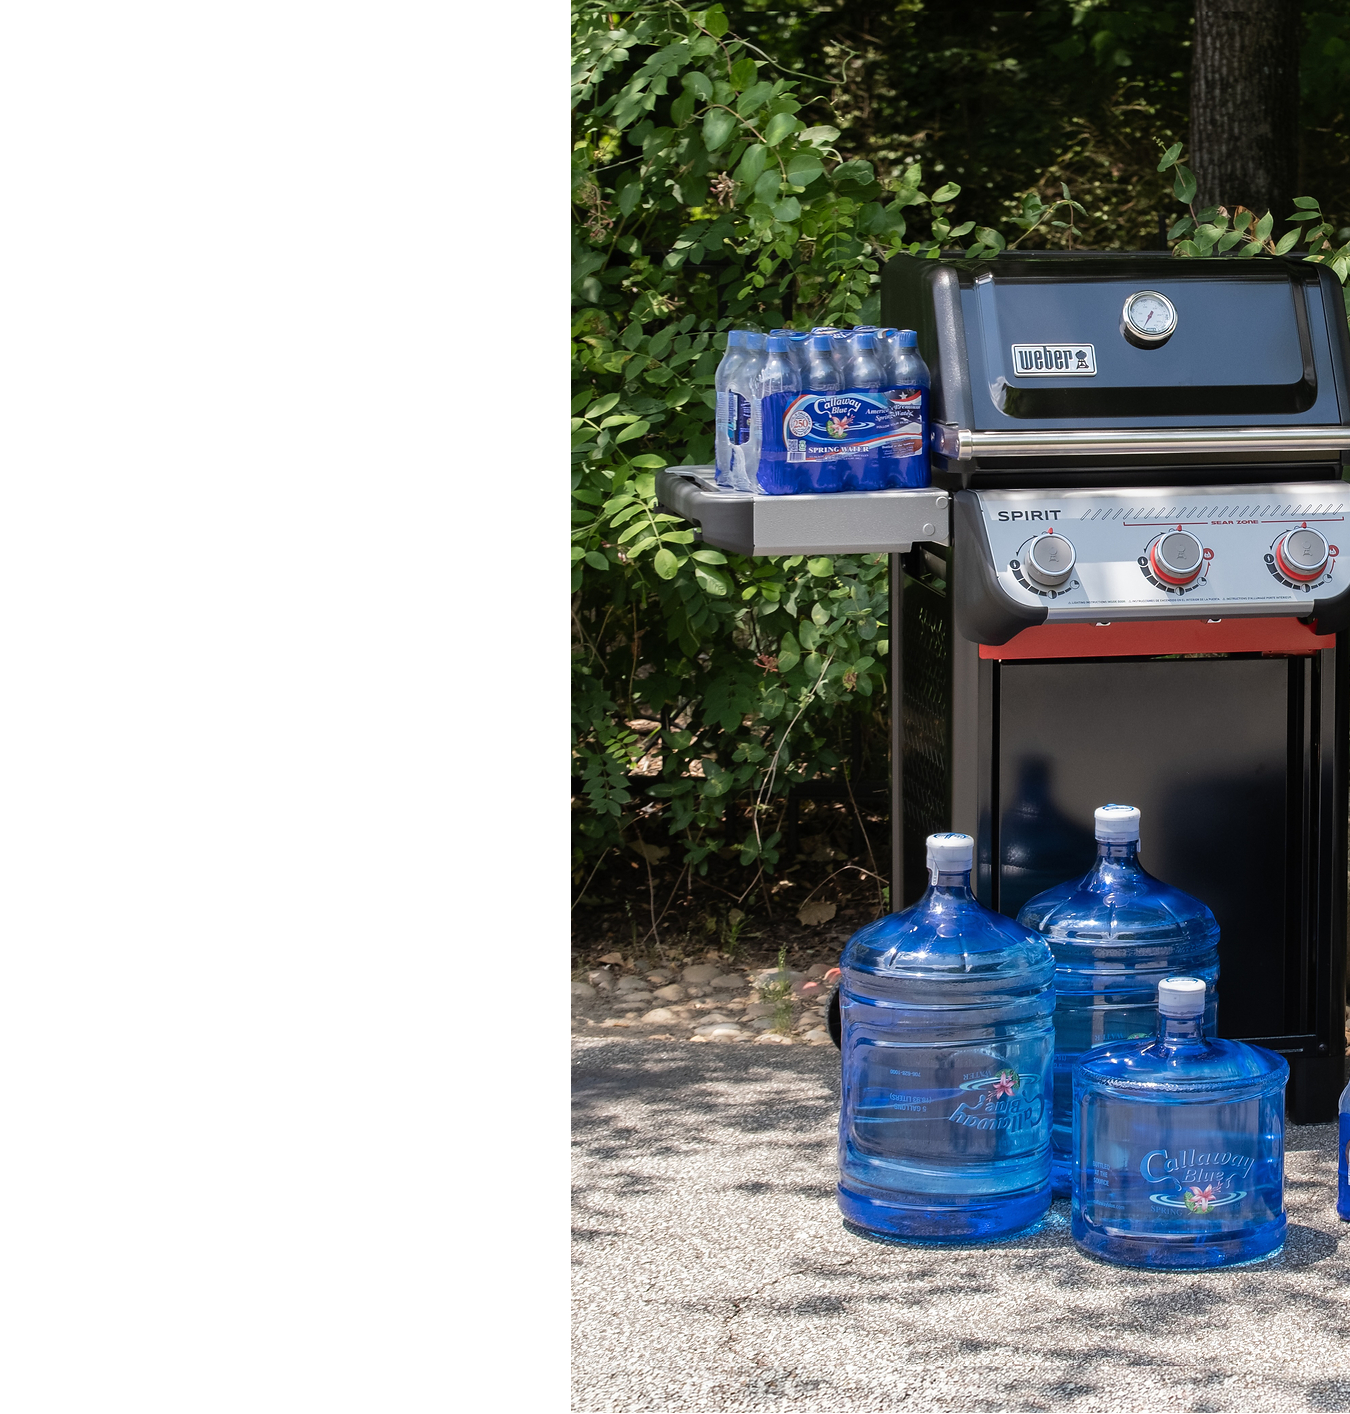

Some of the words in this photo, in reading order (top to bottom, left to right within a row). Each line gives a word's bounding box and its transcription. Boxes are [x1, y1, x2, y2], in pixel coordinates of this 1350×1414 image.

[1018, 346, 1073, 371] weber
[814, 397, 861, 415] Callaway
[832, 407, 848, 415] Blue
[793, 419, 809, 429] 250
[808, 446, 839, 454] SPRING
[998, 510, 1061, 522] SPIRIT
[949, 1094, 1045, 1133] Callaway
[984, 1099, 1020, 1114] Blue
[1140, 1149, 1255, 1184] Callaway
[1182, 1169, 1225, 1183] Blue
[1150, 1204, 1183, 1216] SPRING
